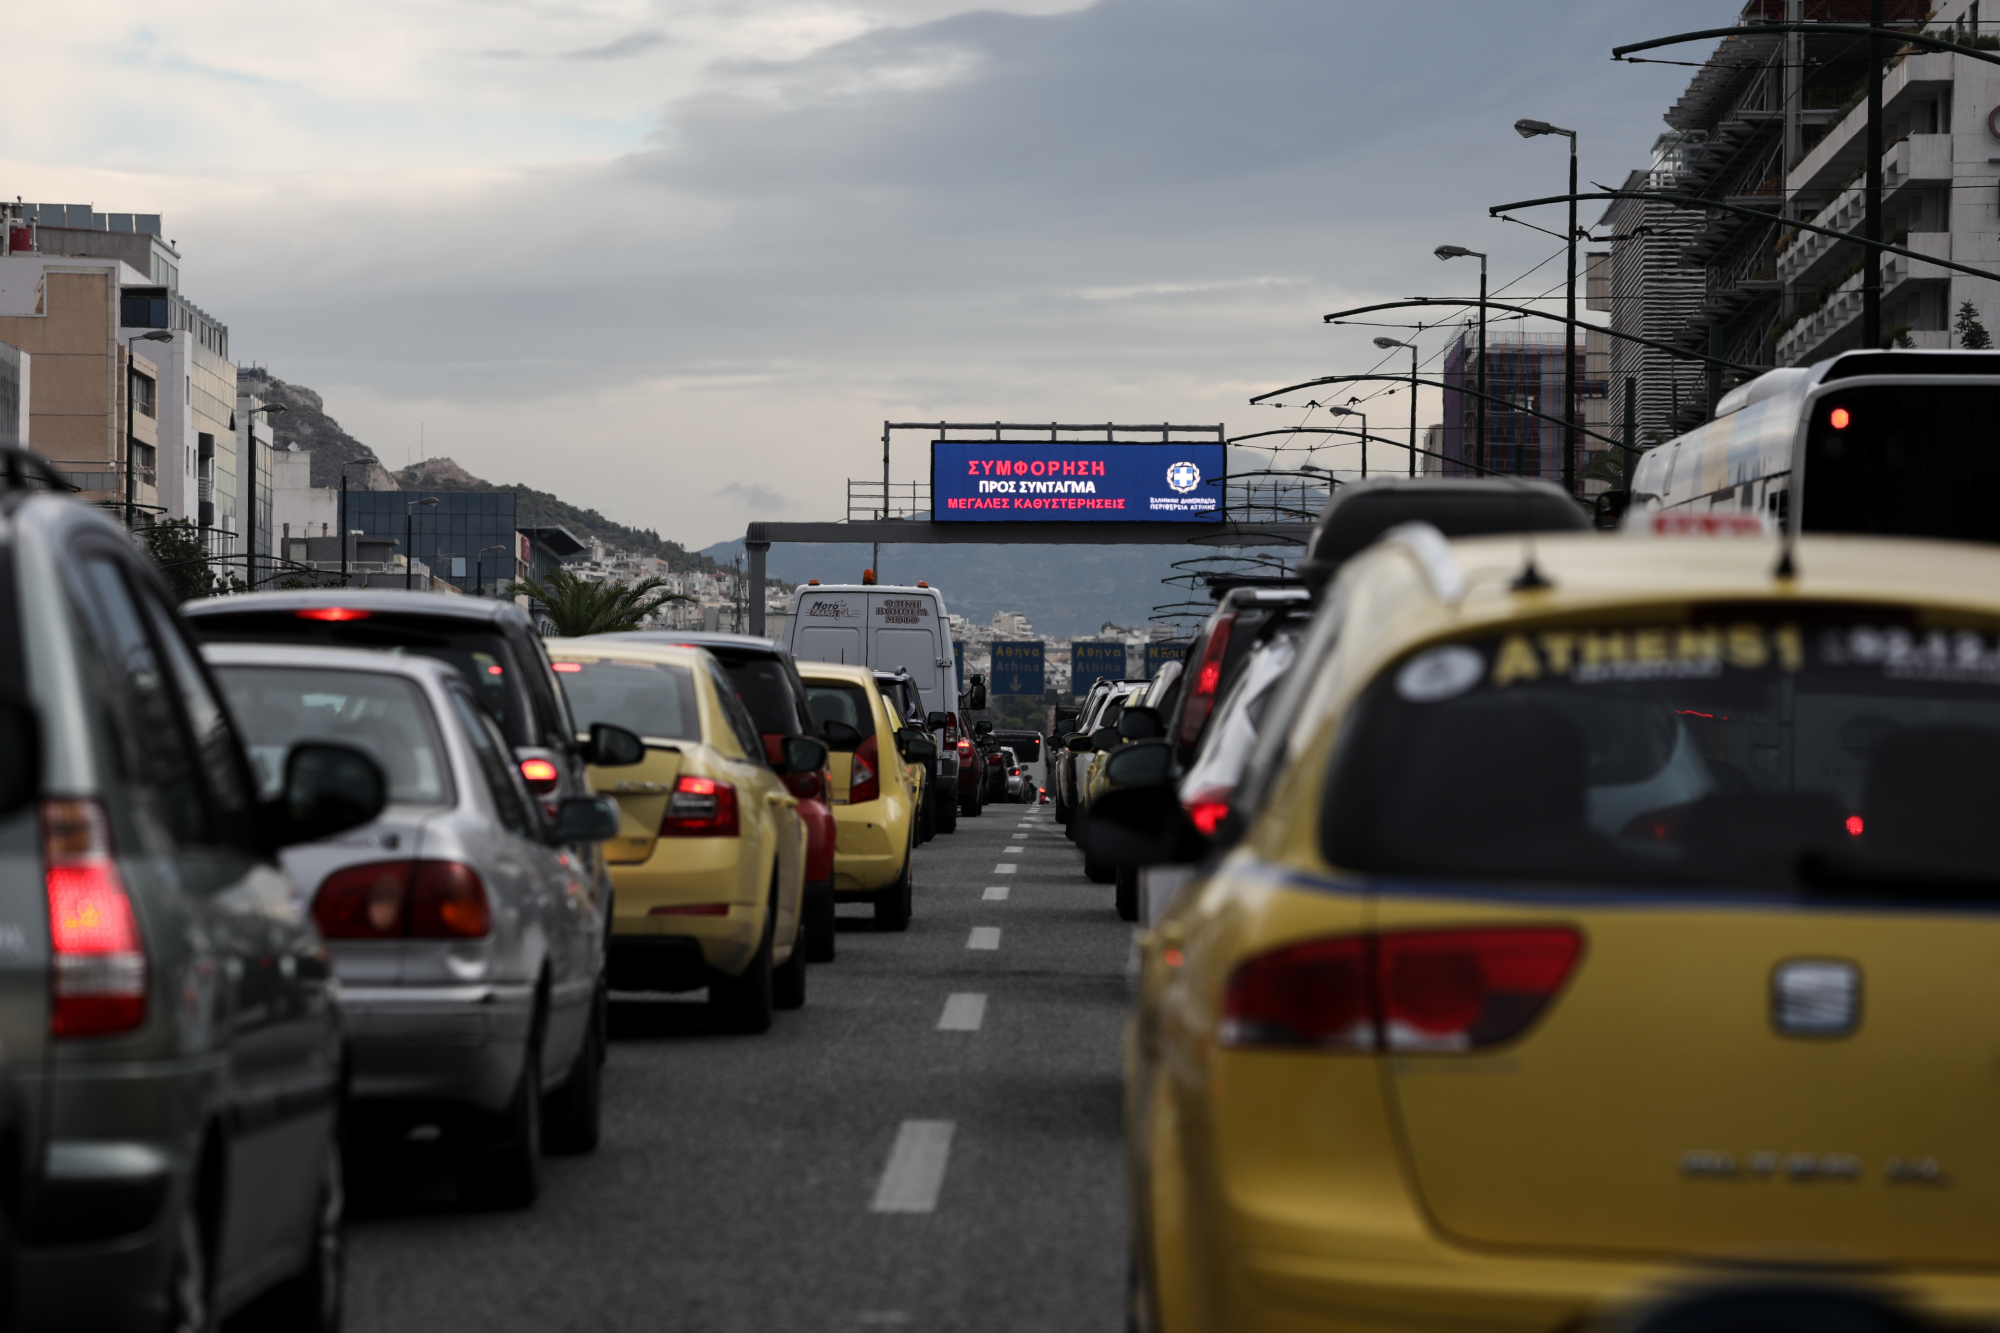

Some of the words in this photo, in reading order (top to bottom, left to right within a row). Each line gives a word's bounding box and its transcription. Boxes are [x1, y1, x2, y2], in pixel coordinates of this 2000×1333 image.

[968, 460, 1105, 476] ΣΥΜΦΟΡΗΣΗ
[979, 481, 1016, 493] ΠΡΟΣ
[1019, 481, 1096, 493] ΣΥΝΤΑΓΜΑ
[947, 498, 1010, 509] ΜΕΓΑΛΕΣ
[1014, 498, 1126, 510] ΚΑΘΥΣΤΕΡΗΣΕΙΣ
[996, 645, 1040, 657] Αθήνα
[1077, 646, 1121, 657] Αθήνα
[996, 661, 1040, 672] Athina
[1077, 661, 1121, 672] Athina
